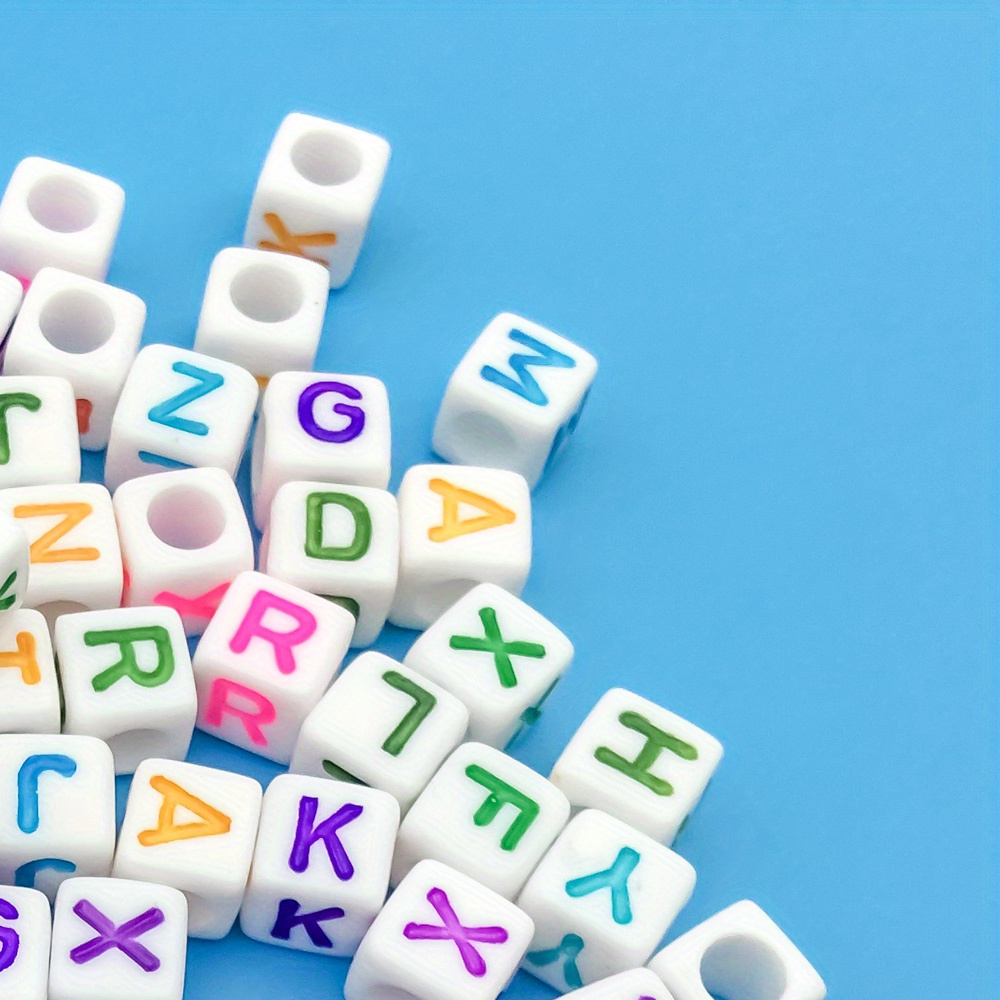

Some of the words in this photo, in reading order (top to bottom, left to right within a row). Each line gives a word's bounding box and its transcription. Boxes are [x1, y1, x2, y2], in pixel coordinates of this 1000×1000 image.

[148, 361, 224, 436] Z
[297, 381, 365, 443] G
[305, 493, 371, 560] D
[428, 478, 516, 542] A
[85, 626, 174, 691] R
[229, 590, 317, 674] R
[450, 608, 545, 688] X
[201, 677, 277, 746] R
[596, 712, 697, 795] H
[137, 775, 232, 846] A
[288, 796, 363, 881] K
[466, 764, 539, 851] F
[565, 846, 640, 925] Y
[70, 900, 164, 972] X
[271, 899, 345, 950] K
[403, 887, 508, 977] X
